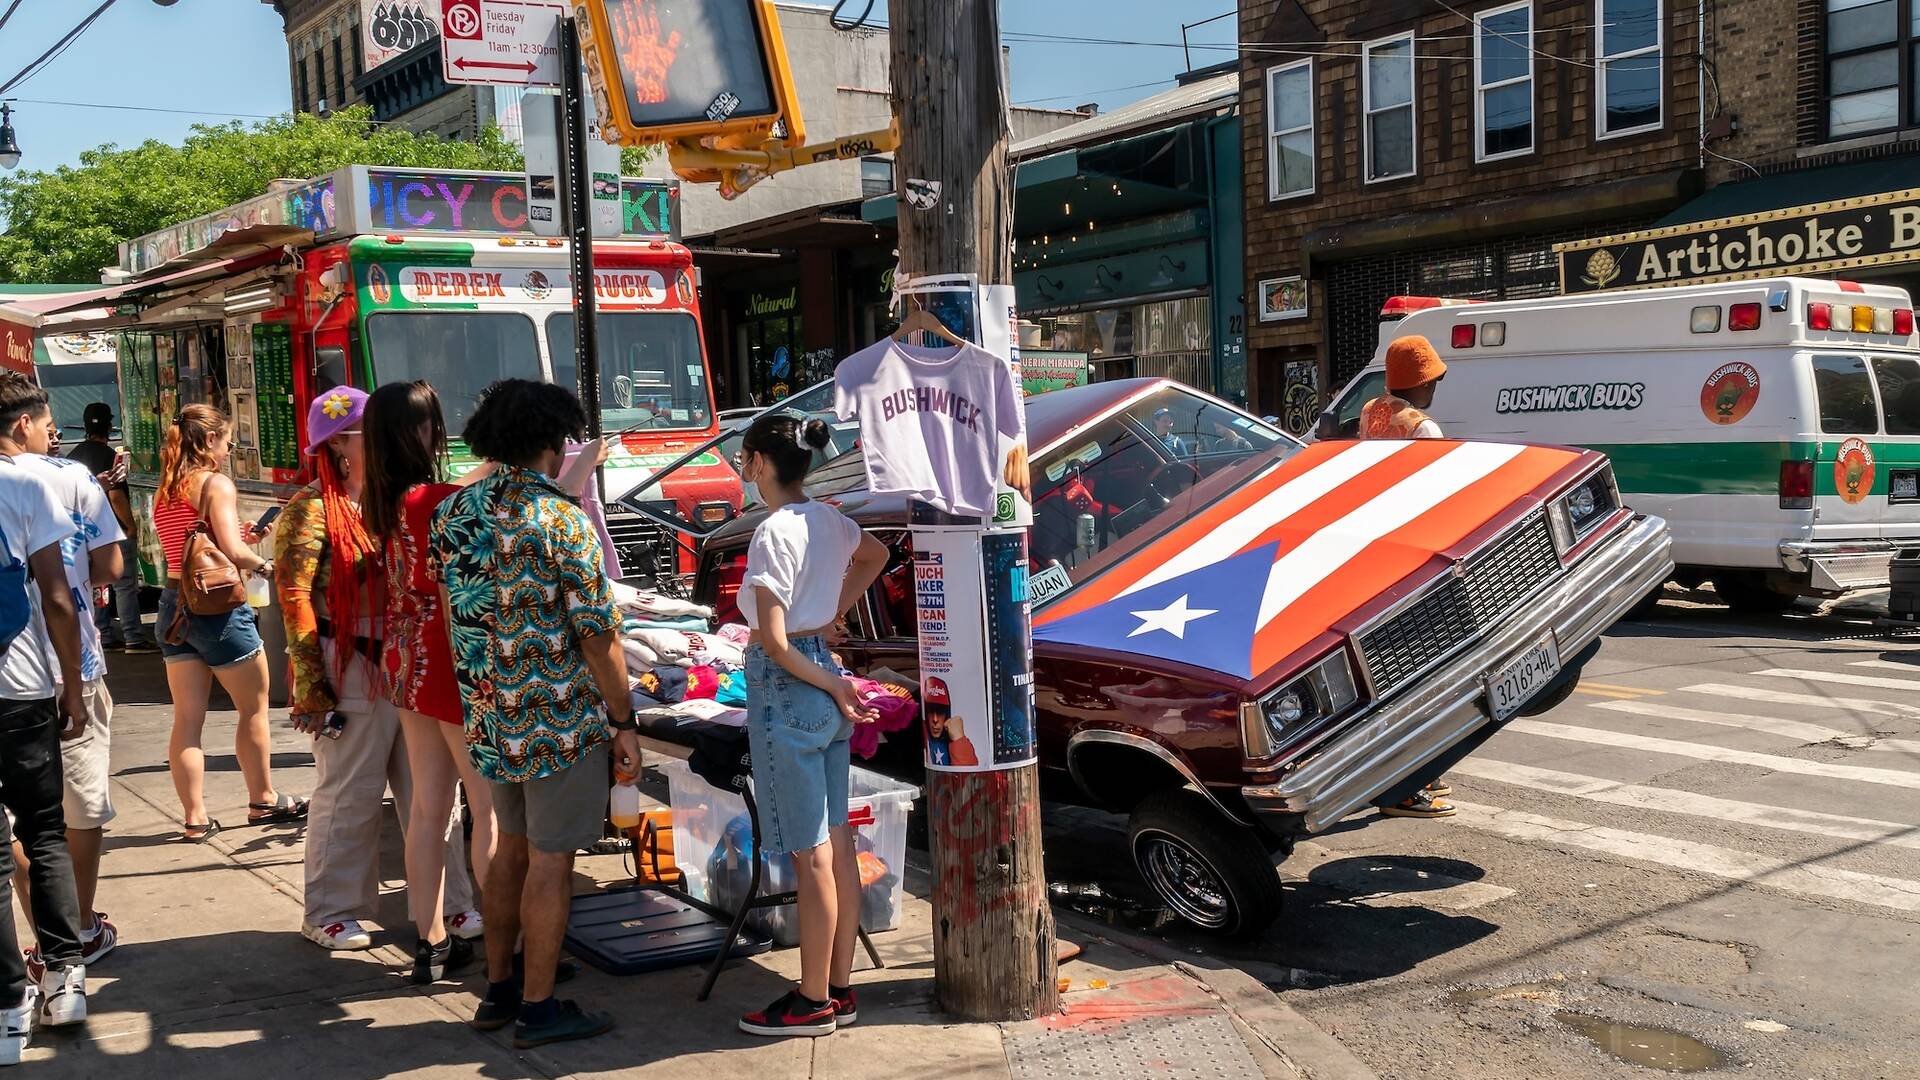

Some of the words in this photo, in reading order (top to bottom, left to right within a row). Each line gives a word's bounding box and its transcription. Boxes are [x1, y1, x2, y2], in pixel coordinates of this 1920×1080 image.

[486, 9, 525, 22] Tuesday
[486, 23, 516, 35] Friday
[488, 41, 511, 53] 11am
[519, 43, 558, 56] 12:30pm
[724, 96, 740, 116] CREW
[1636, 218, 1863, 282] Artichoke
[413, 270, 506, 298] DEREK
[569, 274, 653, 298] RUCK
[745, 287, 796, 316] Natural
[1229, 315, 1242, 335] 22
[1020, 358, 1046, 367] UERIA
[1047, 359, 1085, 368] MIRANDA
[1707, 362, 1745, 387] BUSHWICK
[1743, 364, 1759, 388] BUDS
[882, 386, 981, 434] BUSHWICK
[1497, 385, 1591, 413] BUSHWICK
[1589, 382, 1645, 410] BUDS
[1031, 574, 1065, 600] JUAN
[1506, 662, 1522, 676] NEW
[1522, 647, 1540, 662] YORK
